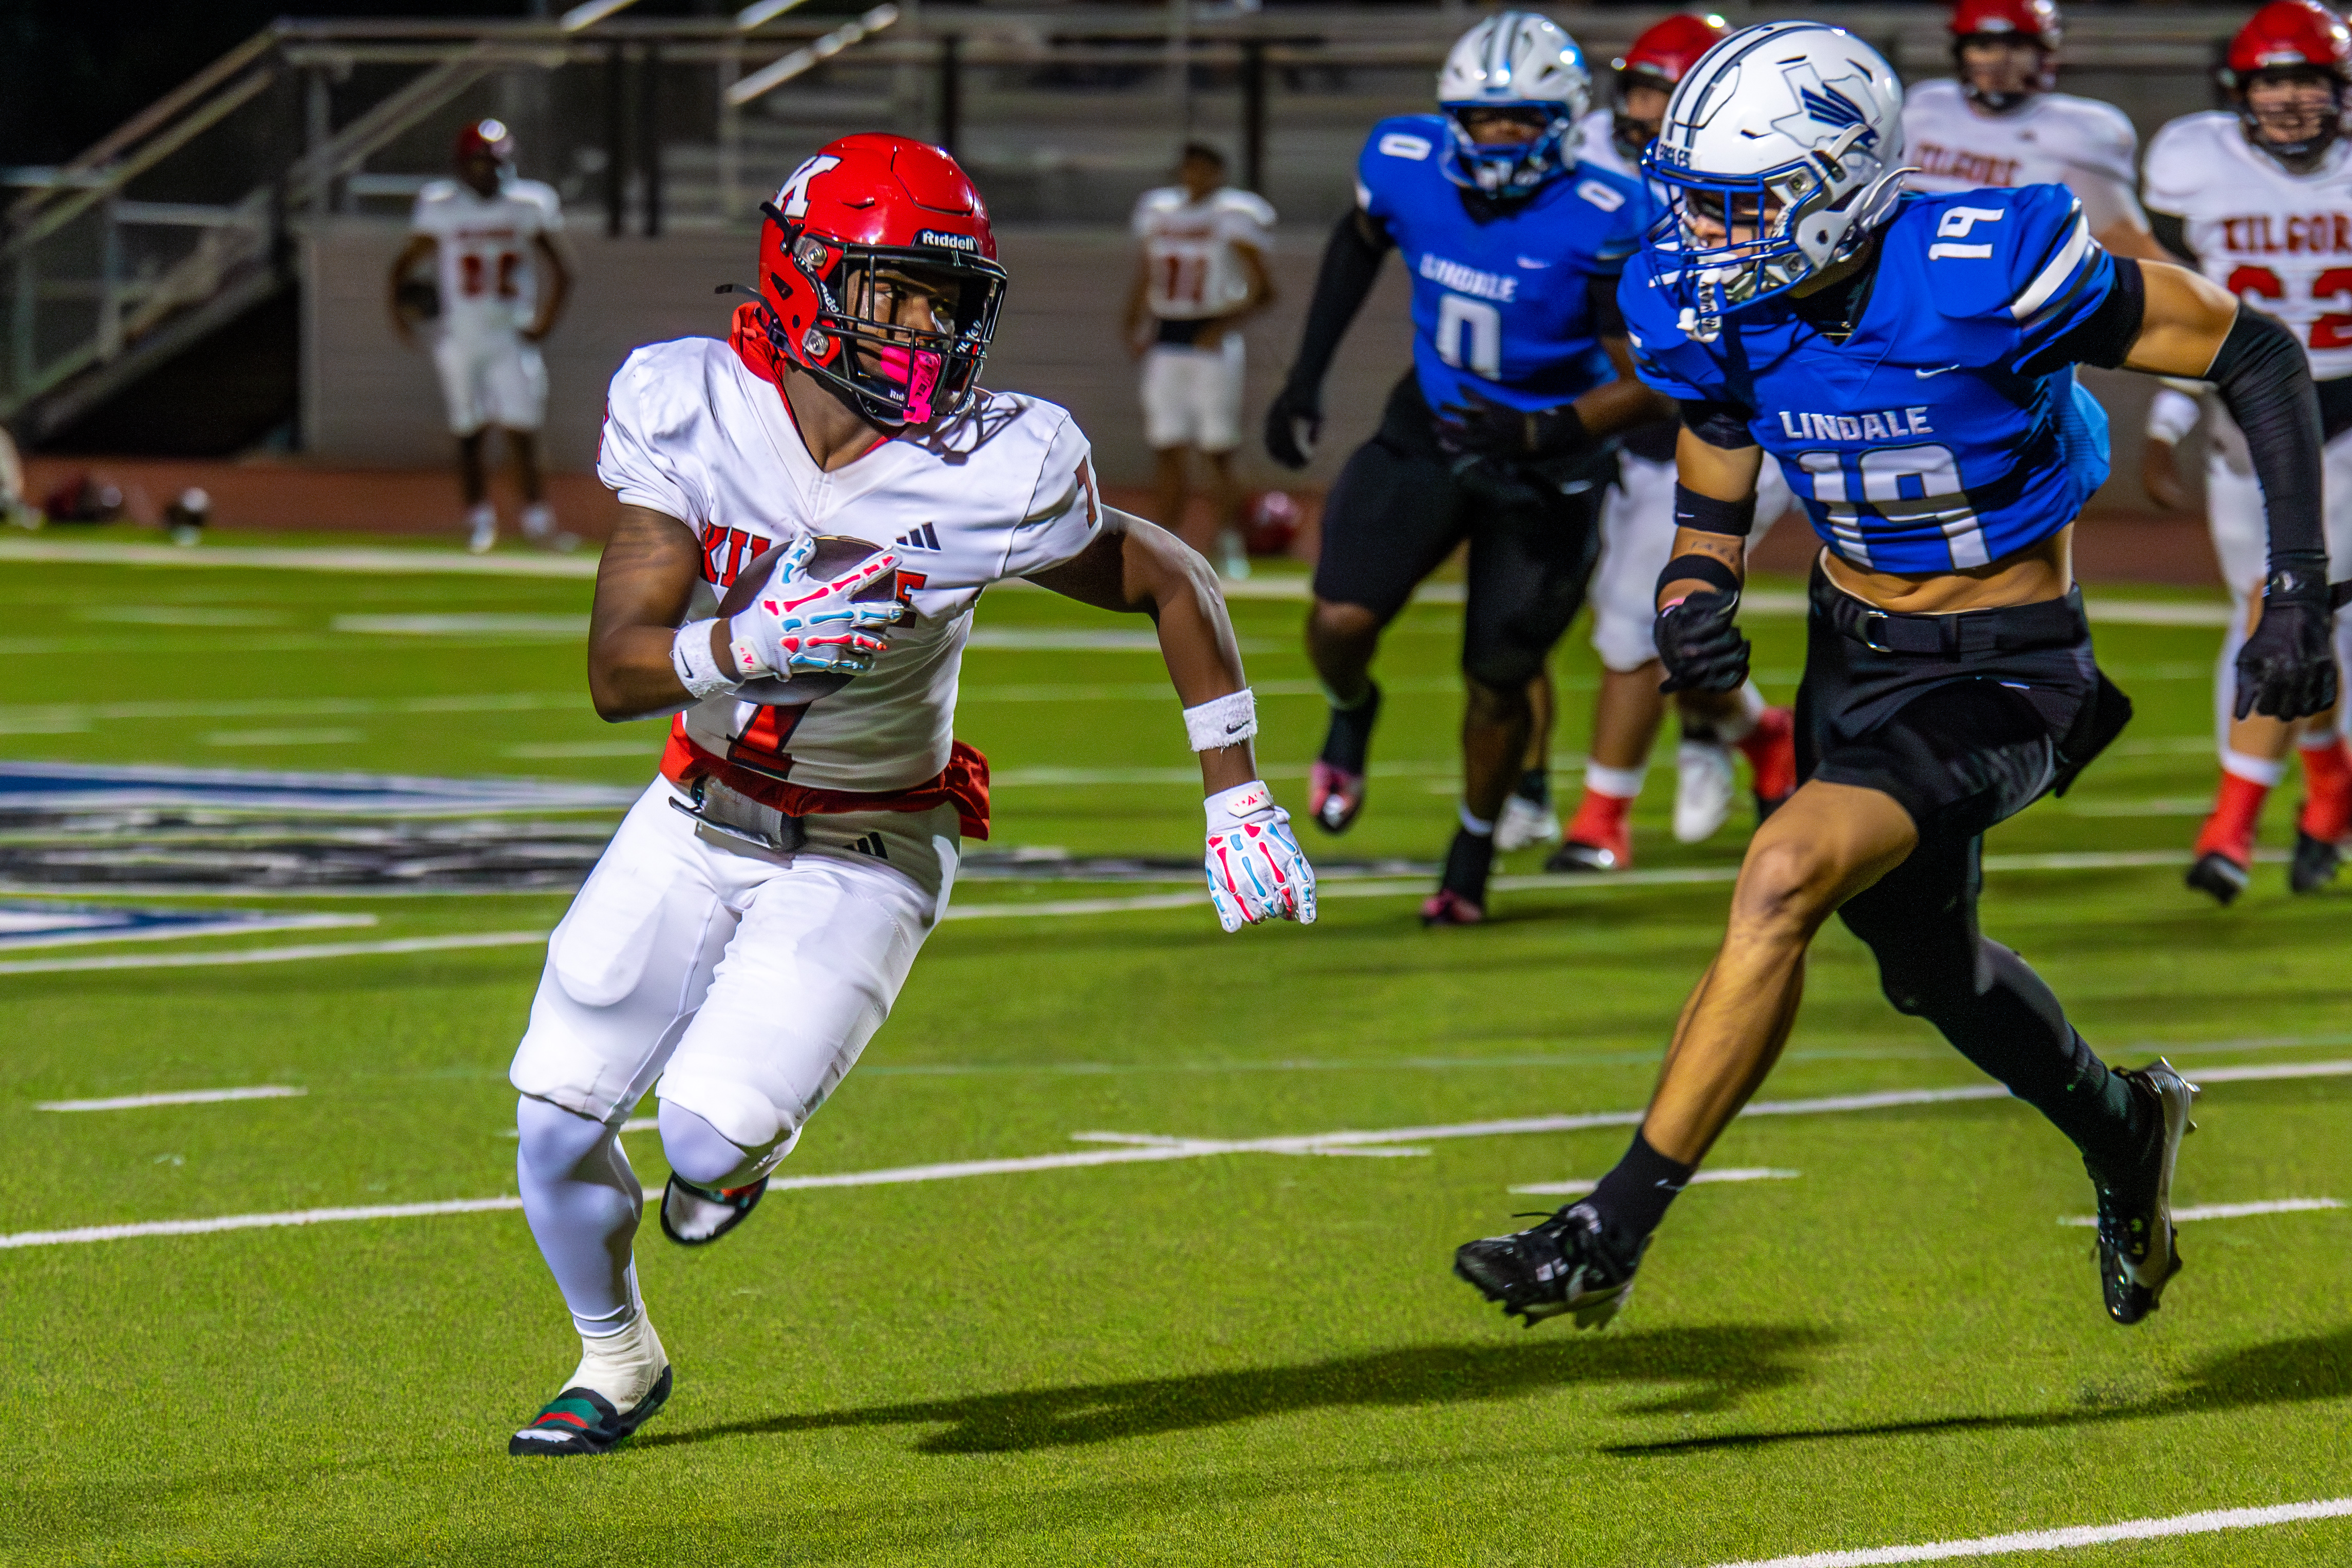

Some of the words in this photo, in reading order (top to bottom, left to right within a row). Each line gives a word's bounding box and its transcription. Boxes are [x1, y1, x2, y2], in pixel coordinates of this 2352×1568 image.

[773, 154, 843, 219] K
[923, 230, 974, 251] Riddell
[1928, 206, 2005, 261] 19
[1779, 406, 1934, 441] LINDALE
[1796, 442, 1992, 570] 19
